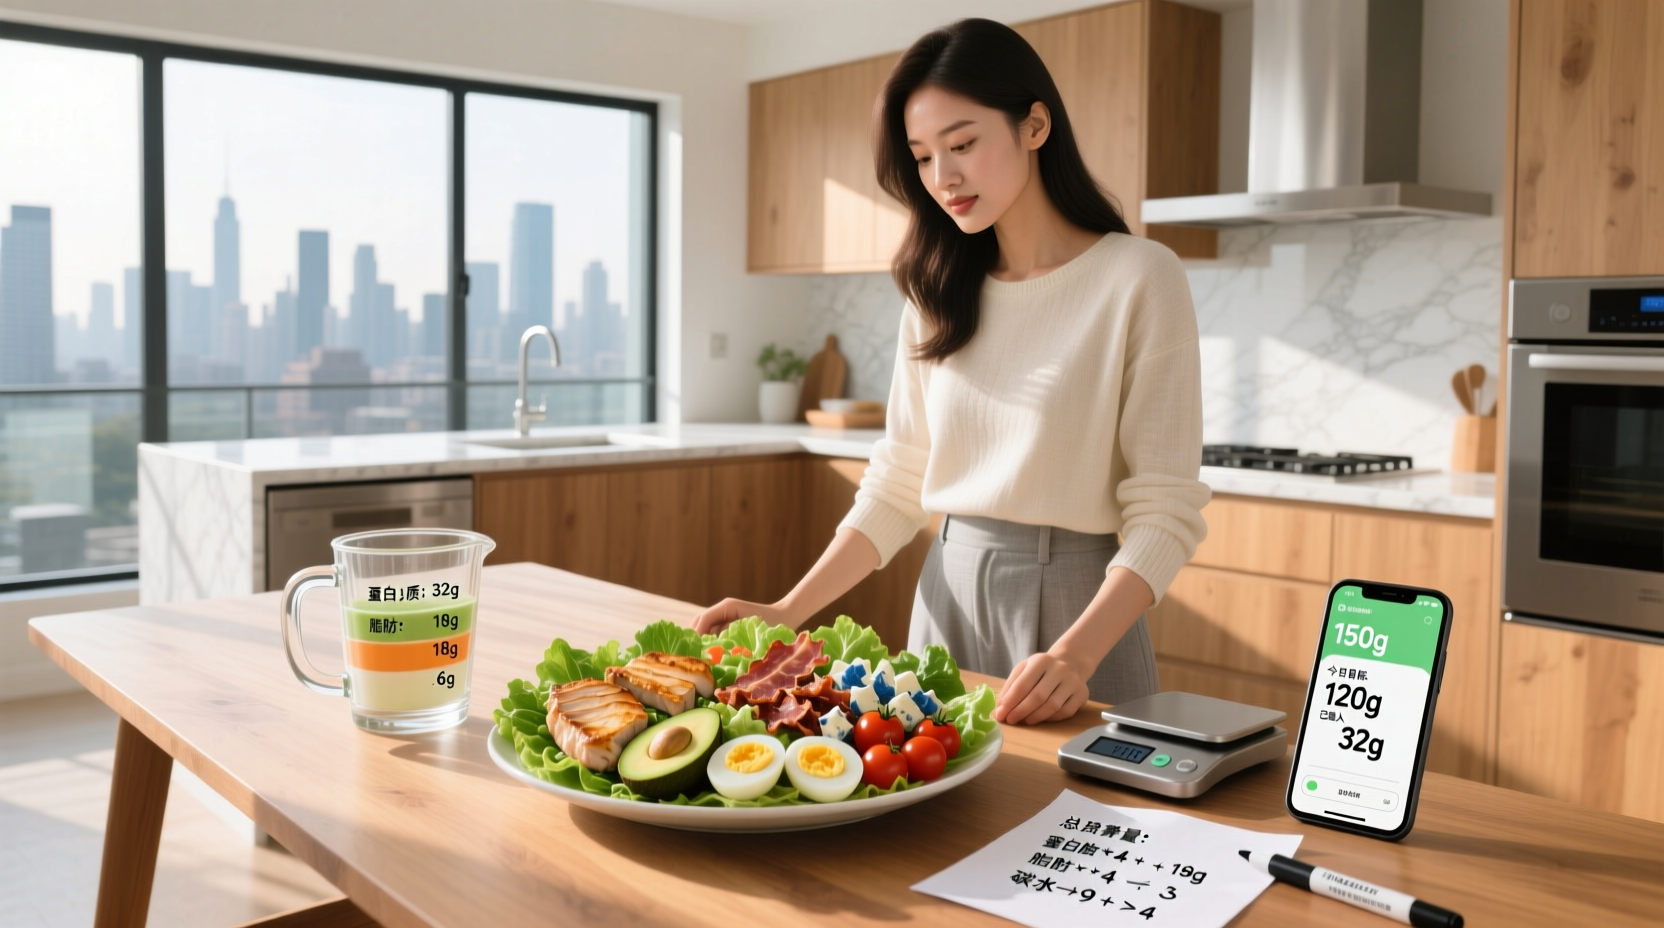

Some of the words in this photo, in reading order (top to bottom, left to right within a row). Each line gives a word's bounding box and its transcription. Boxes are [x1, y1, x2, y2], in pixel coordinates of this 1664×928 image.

[432, 582, 460, 600] 32g
[432, 640, 458, 659] 18g
[1334, 622, 1389, 657] 150g
[1325, 682, 1383, 719] 120g
[1338, 726, 1385, 762] 32g
[1158, 885, 1177, 900] 3
